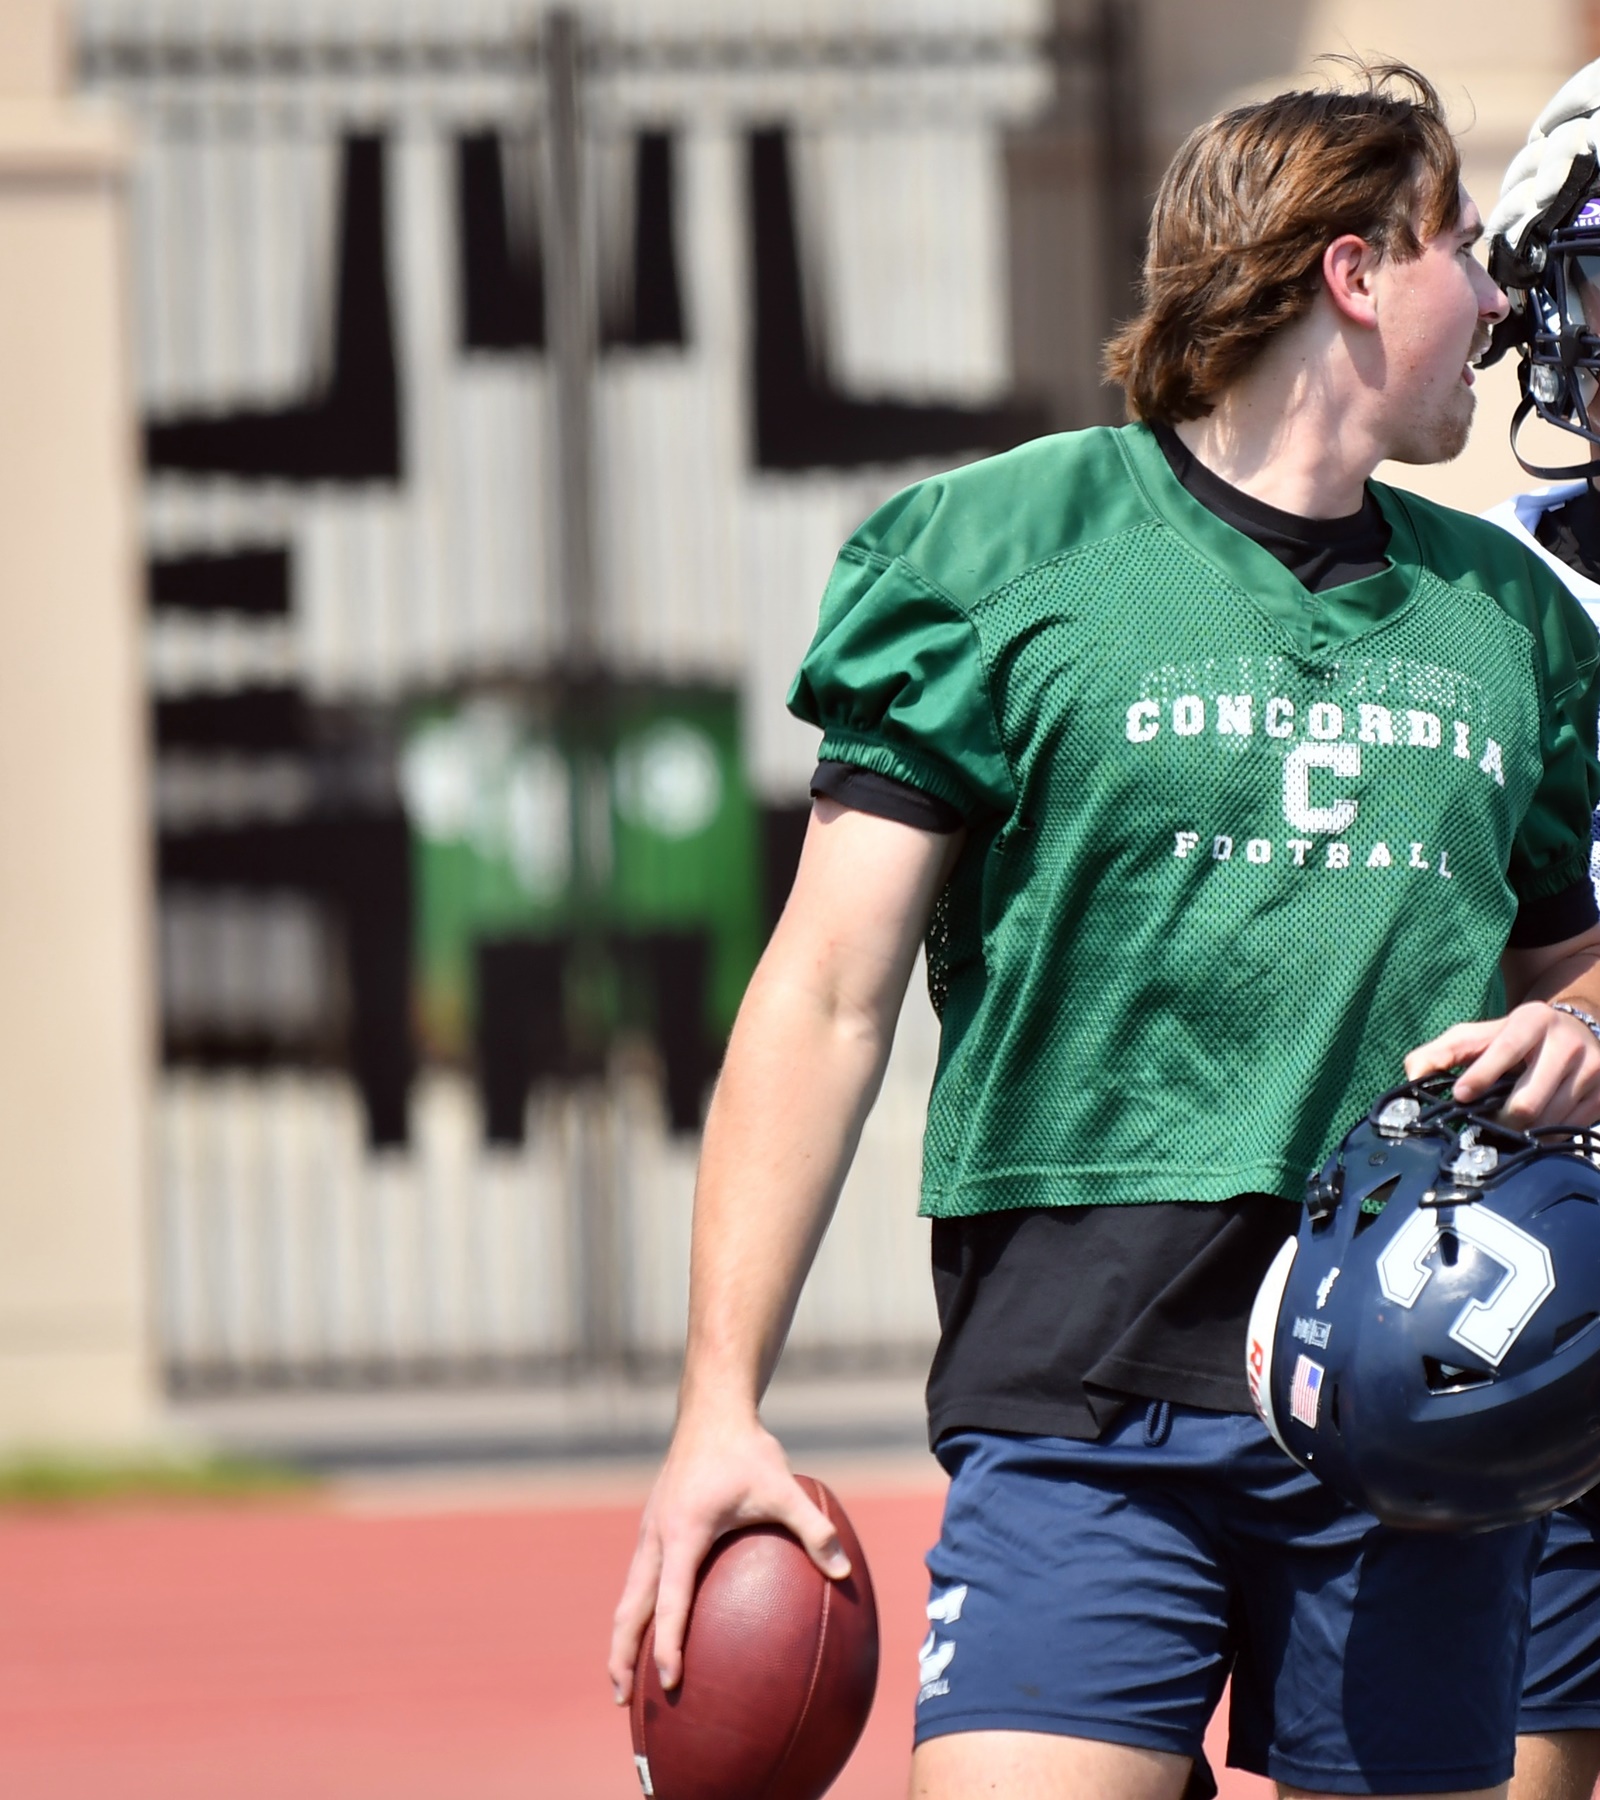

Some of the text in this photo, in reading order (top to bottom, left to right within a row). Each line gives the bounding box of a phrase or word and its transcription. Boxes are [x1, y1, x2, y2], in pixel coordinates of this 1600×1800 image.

[1125, 694, 1506, 788] CONCORDIA
[1282, 741, 1361, 834] C
[1172, 830, 1453, 879] FOOTBALL
